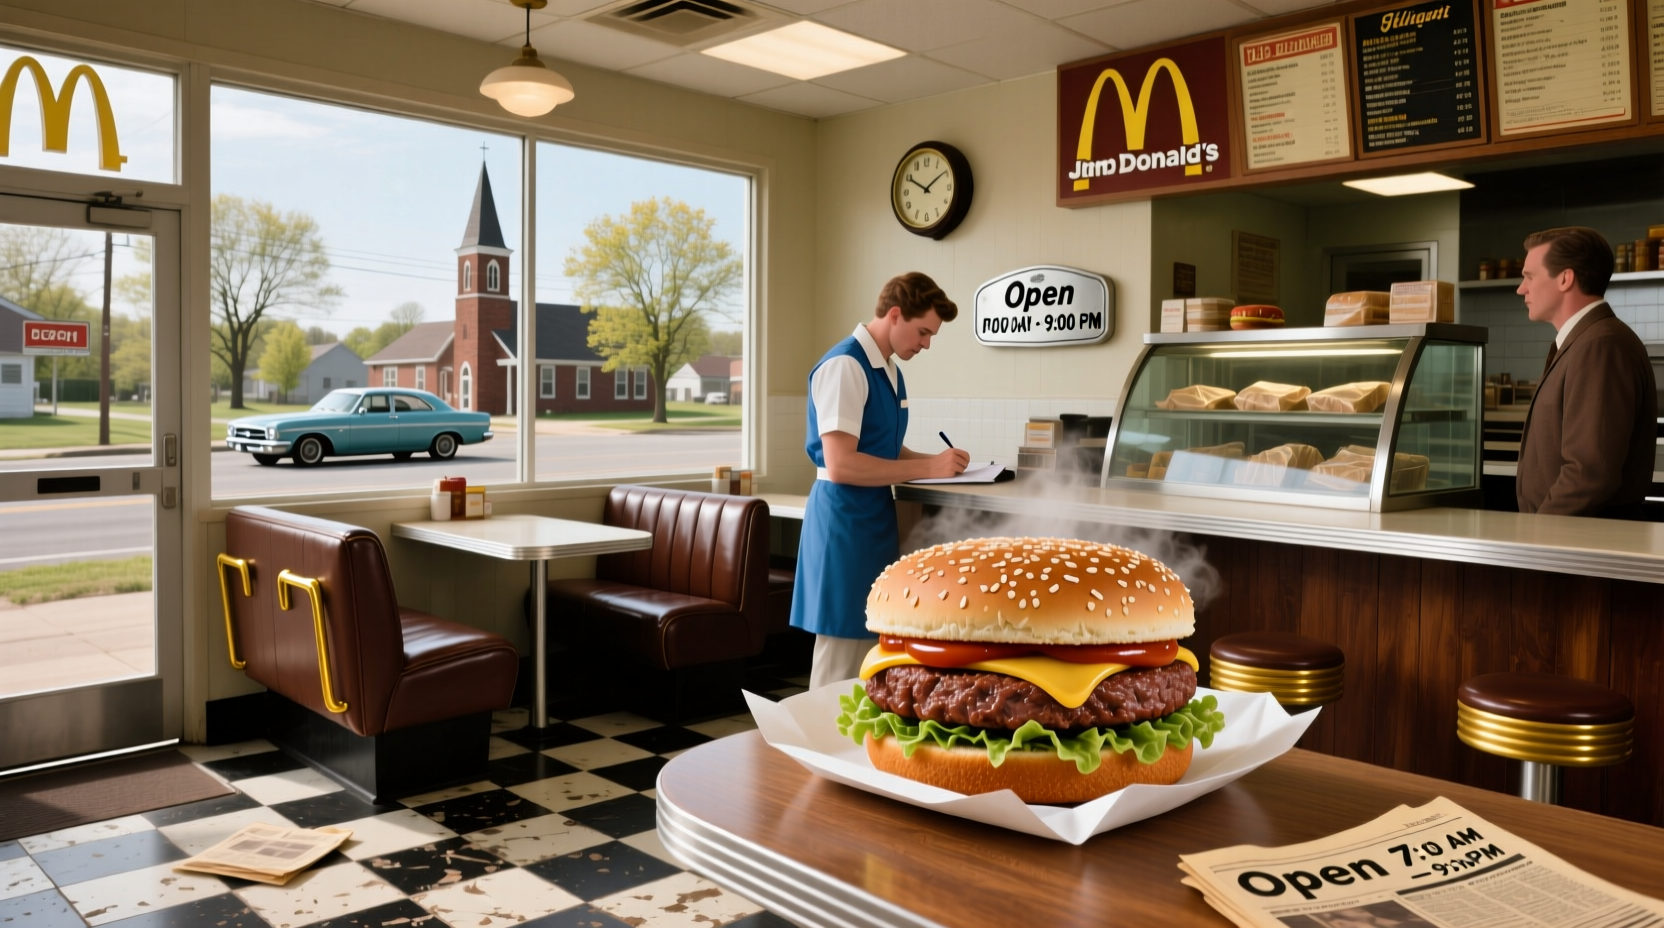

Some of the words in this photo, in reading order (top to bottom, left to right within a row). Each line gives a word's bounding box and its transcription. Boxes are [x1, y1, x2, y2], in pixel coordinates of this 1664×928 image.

[1119, 142, 1220, 174] Donald's
[1004, 280, 1075, 312] Open
[1044, 313, 1075, 332] 9:00
[1079, 312, 1102, 330] PM
[1237, 857, 1390, 900] Open
[1445, 827, 1484, 850] AM
